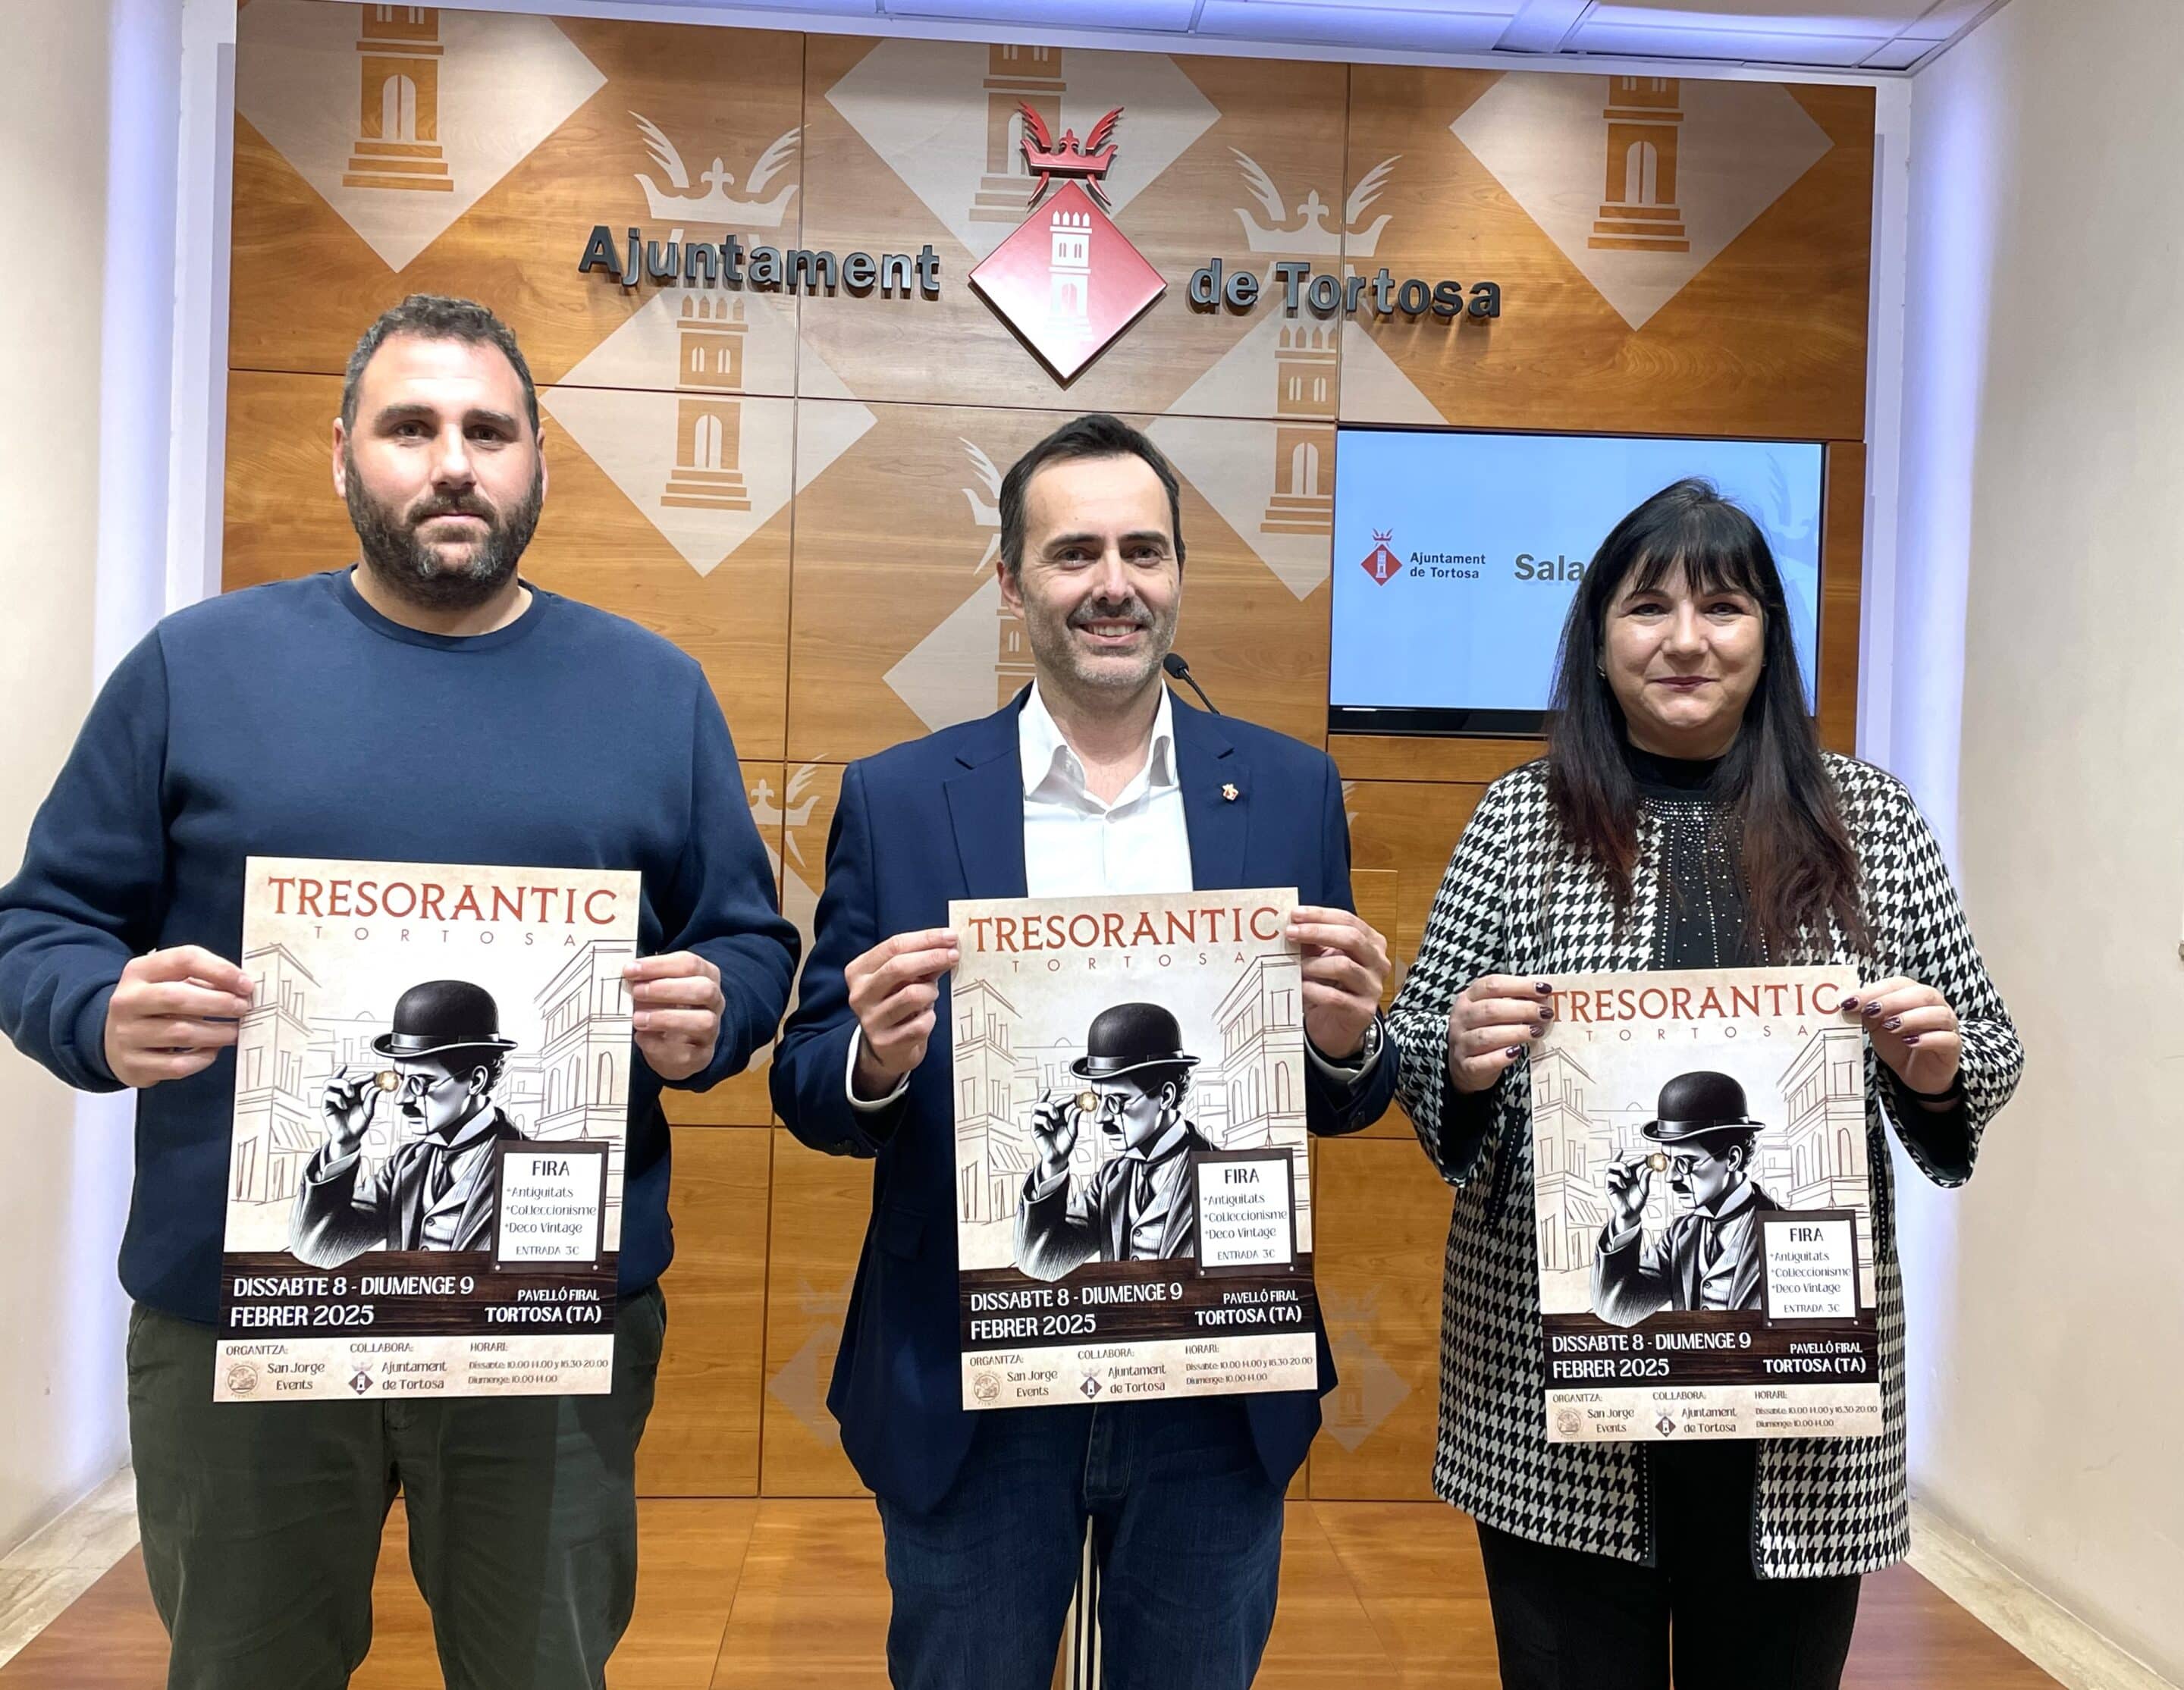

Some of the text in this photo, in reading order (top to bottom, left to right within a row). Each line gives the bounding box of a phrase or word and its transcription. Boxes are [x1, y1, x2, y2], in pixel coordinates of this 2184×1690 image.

[578, 225, 940, 301] Ajuntament
[1191, 259, 1502, 318] de Tortosa
[1410, 552, 1486, 565] Ajuntament
[1410, 566, 1480, 579] de Tortosa
[1514, 553, 1585, 582] Sala
[268, 876, 617, 925] TRESORANTIC
[314, 926, 576, 946] TORTOSA
[968, 907, 1280, 953] TRESORANTIC
[1012, 952, 1245, 973] TORTOSA
[1548, 983, 1840, 1023] TRESORANTIC
[1586, 1024, 1809, 1042] TORTOSA
[532, 1160, 570, 1176] FIRA
[1225, 1168, 1260, 1184] FIRA
[540, 1222, 582, 1235] Vintage
[1238, 1228, 1276, 1240] Vintage
[1790, 1228, 1824, 1242] FIRA
[516, 1246, 561, 1256] ENTRADA
[1217, 1249, 1259, 1260] ENTRADA
[234, 1278, 329, 1297] DISSABTE
[332, 1277, 347, 1295] 8
[361, 1277, 456, 1295] DIUMENGE
[460, 1277, 474, 1294] 9
[1803, 1283, 1841, 1294] Vintage
[517, 1287, 600, 1302] PAVELLÓ FIRAL
[971, 1290, 1053, 1312] DISSABTE
[1057, 1289, 1069, 1306] 8
[1081, 1284, 1166, 1305] DIUMENGE
[1170, 1283, 1183, 1300] 9
[1223, 1289, 1298, 1305] PAVELLÓ FIRAL
[485, 1306, 602, 1323] TORTOSA (TA)
[1784, 1303, 1823, 1313] ENTRADA
[231, 1304, 375, 1328] FEBRER 2025
[1194, 1305, 1302, 1326] TORTOSA (TA)
[970, 1313, 1097, 1340] FEBRER 2025
[1552, 1335, 1629, 1352] DISSABTE
[1633, 1334, 1644, 1350] 8
[1655, 1333, 1736, 1350] DIUMENGE
[1739, 1332, 1751, 1349] 9
[1790, 1340, 1863, 1354] PAVELLÓ FIRAL
[226, 1345, 288, 1355] ORGANITZA:
[969, 1355, 1024, 1367] ORGANITZA:
[1552, 1358, 1670, 1378] FEBRER 2025
[1763, 1357, 1866, 1374] TORTOSA (TA)
[267, 1363, 289, 1374] San
[290, 1362, 325, 1375] Jorge
[381, 1362, 447, 1375] Ajuntament
[1007, 1371, 1025, 1382] San
[1028, 1369, 1059, 1381] Jorge
[1108, 1364, 1166, 1378] Ajuntament
[276, 1380, 313, 1390] Events
[382, 1378, 444, 1390] de Tortosa
[1110, 1381, 1166, 1394] de Tortosa
[1016, 1387, 1050, 1397] Events
[1552, 1394, 1602, 1403] ORGANITZA:
[1587, 1409, 1605, 1419] San
[1607, 1409, 1634, 1419] Jorge
[1681, 1407, 1737, 1419] Ajuntament
[1596, 1423, 1627, 1433] Events
[1684, 1422, 1737, 1432] de Tortosa
